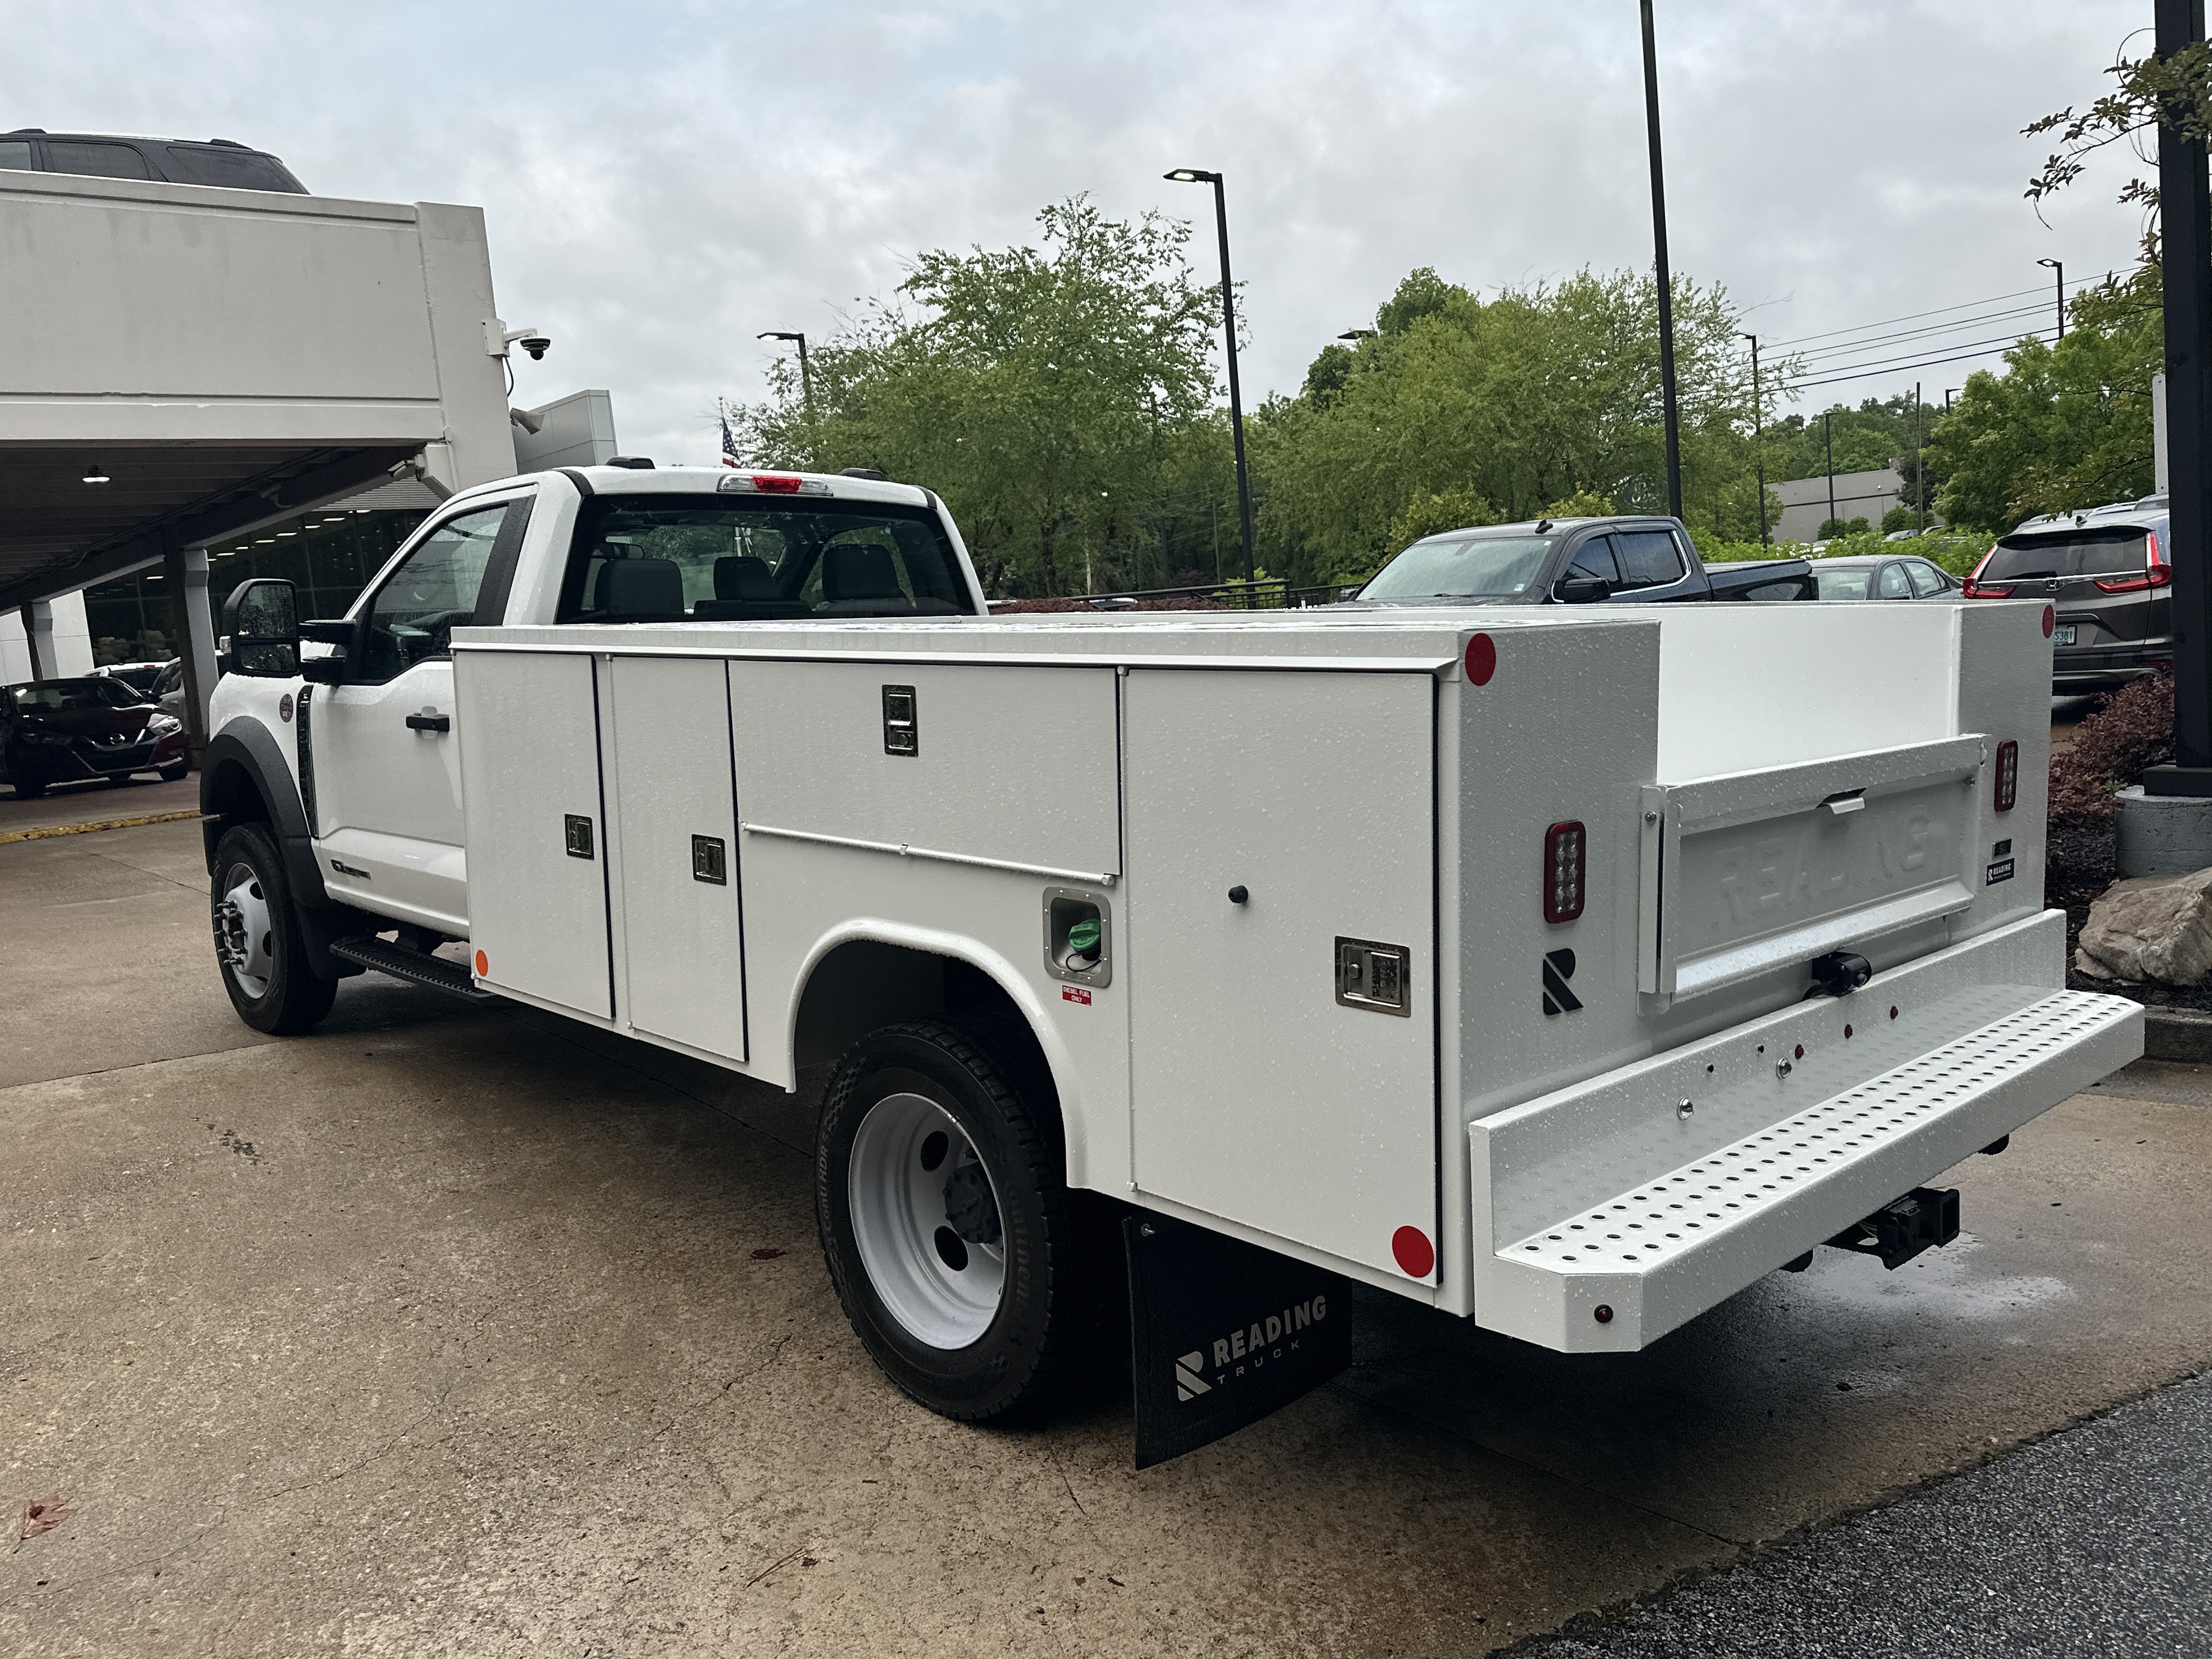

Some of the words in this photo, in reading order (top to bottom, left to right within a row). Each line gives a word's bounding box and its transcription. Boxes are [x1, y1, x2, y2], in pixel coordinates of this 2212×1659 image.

[1063, 986, 1079, 995] DIESEL
[1079, 990, 1091, 998] FUEL
[1071, 995, 1082, 1003] ONLY
[1213, 1295, 1326, 1368] READING
[1217, 1340, 1300, 1385] TRUCK
